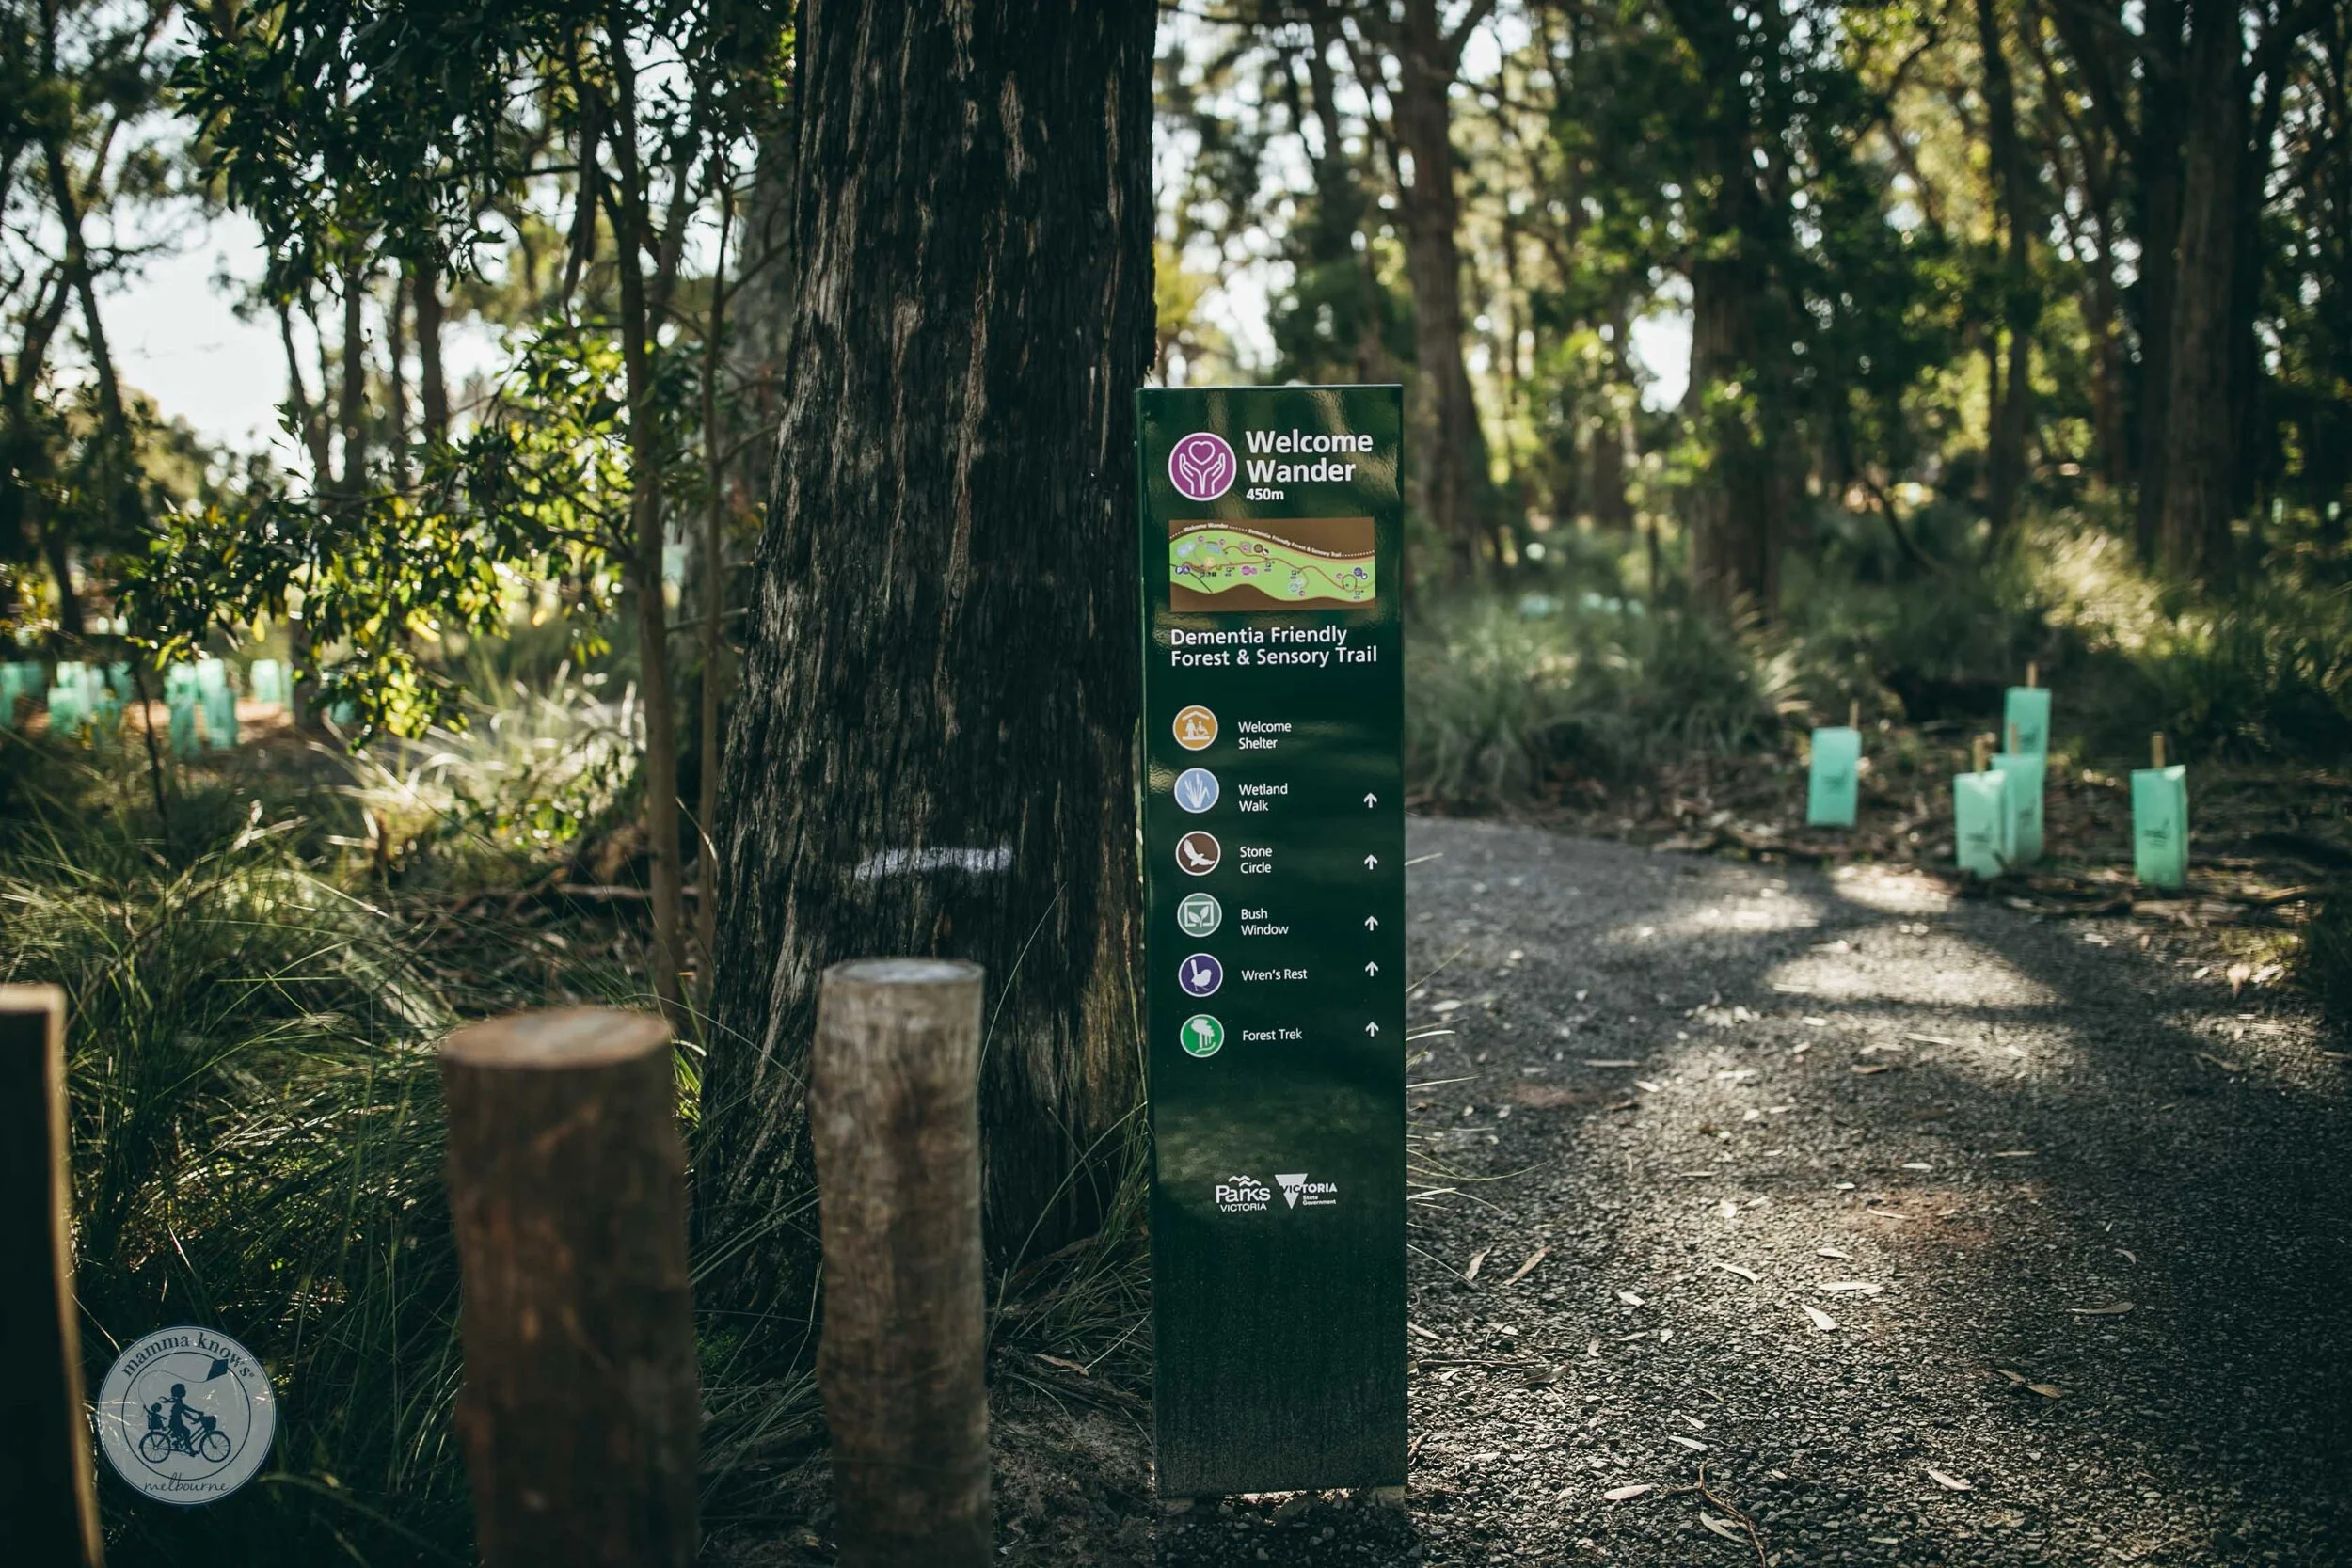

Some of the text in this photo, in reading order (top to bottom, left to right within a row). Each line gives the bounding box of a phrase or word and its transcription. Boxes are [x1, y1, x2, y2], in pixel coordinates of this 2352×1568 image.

[1246, 429, 1373, 453] Welcome
[1246, 457, 1355, 482] Wander
[1246, 488, 1284, 500] 450m
[1170, 626, 1347, 646] Dementia Friendly
[1171, 645, 1377, 668] Forest & Sensory Trail
[1238, 721, 1292, 733] Welcome
[1238, 737, 1278, 750] Shelter
[1239, 784, 1288, 796] Wetland
[1239, 800, 1269, 812] Walk
[1240, 847, 1272, 858] Stone
[1240, 862, 1271, 873] Circle
[1241, 908, 1267, 920] Bush
[1241, 924, 1289, 935] Window
[1241, 968, 1308, 981] Wren's Rest
[1242, 1028, 1302, 1041] Forest Trek
[1216, 1185, 1271, 1203] Parks
[1281, 1183, 1338, 1194] VICTORIA
[1220, 1203, 1267, 1212] VICTORIA
